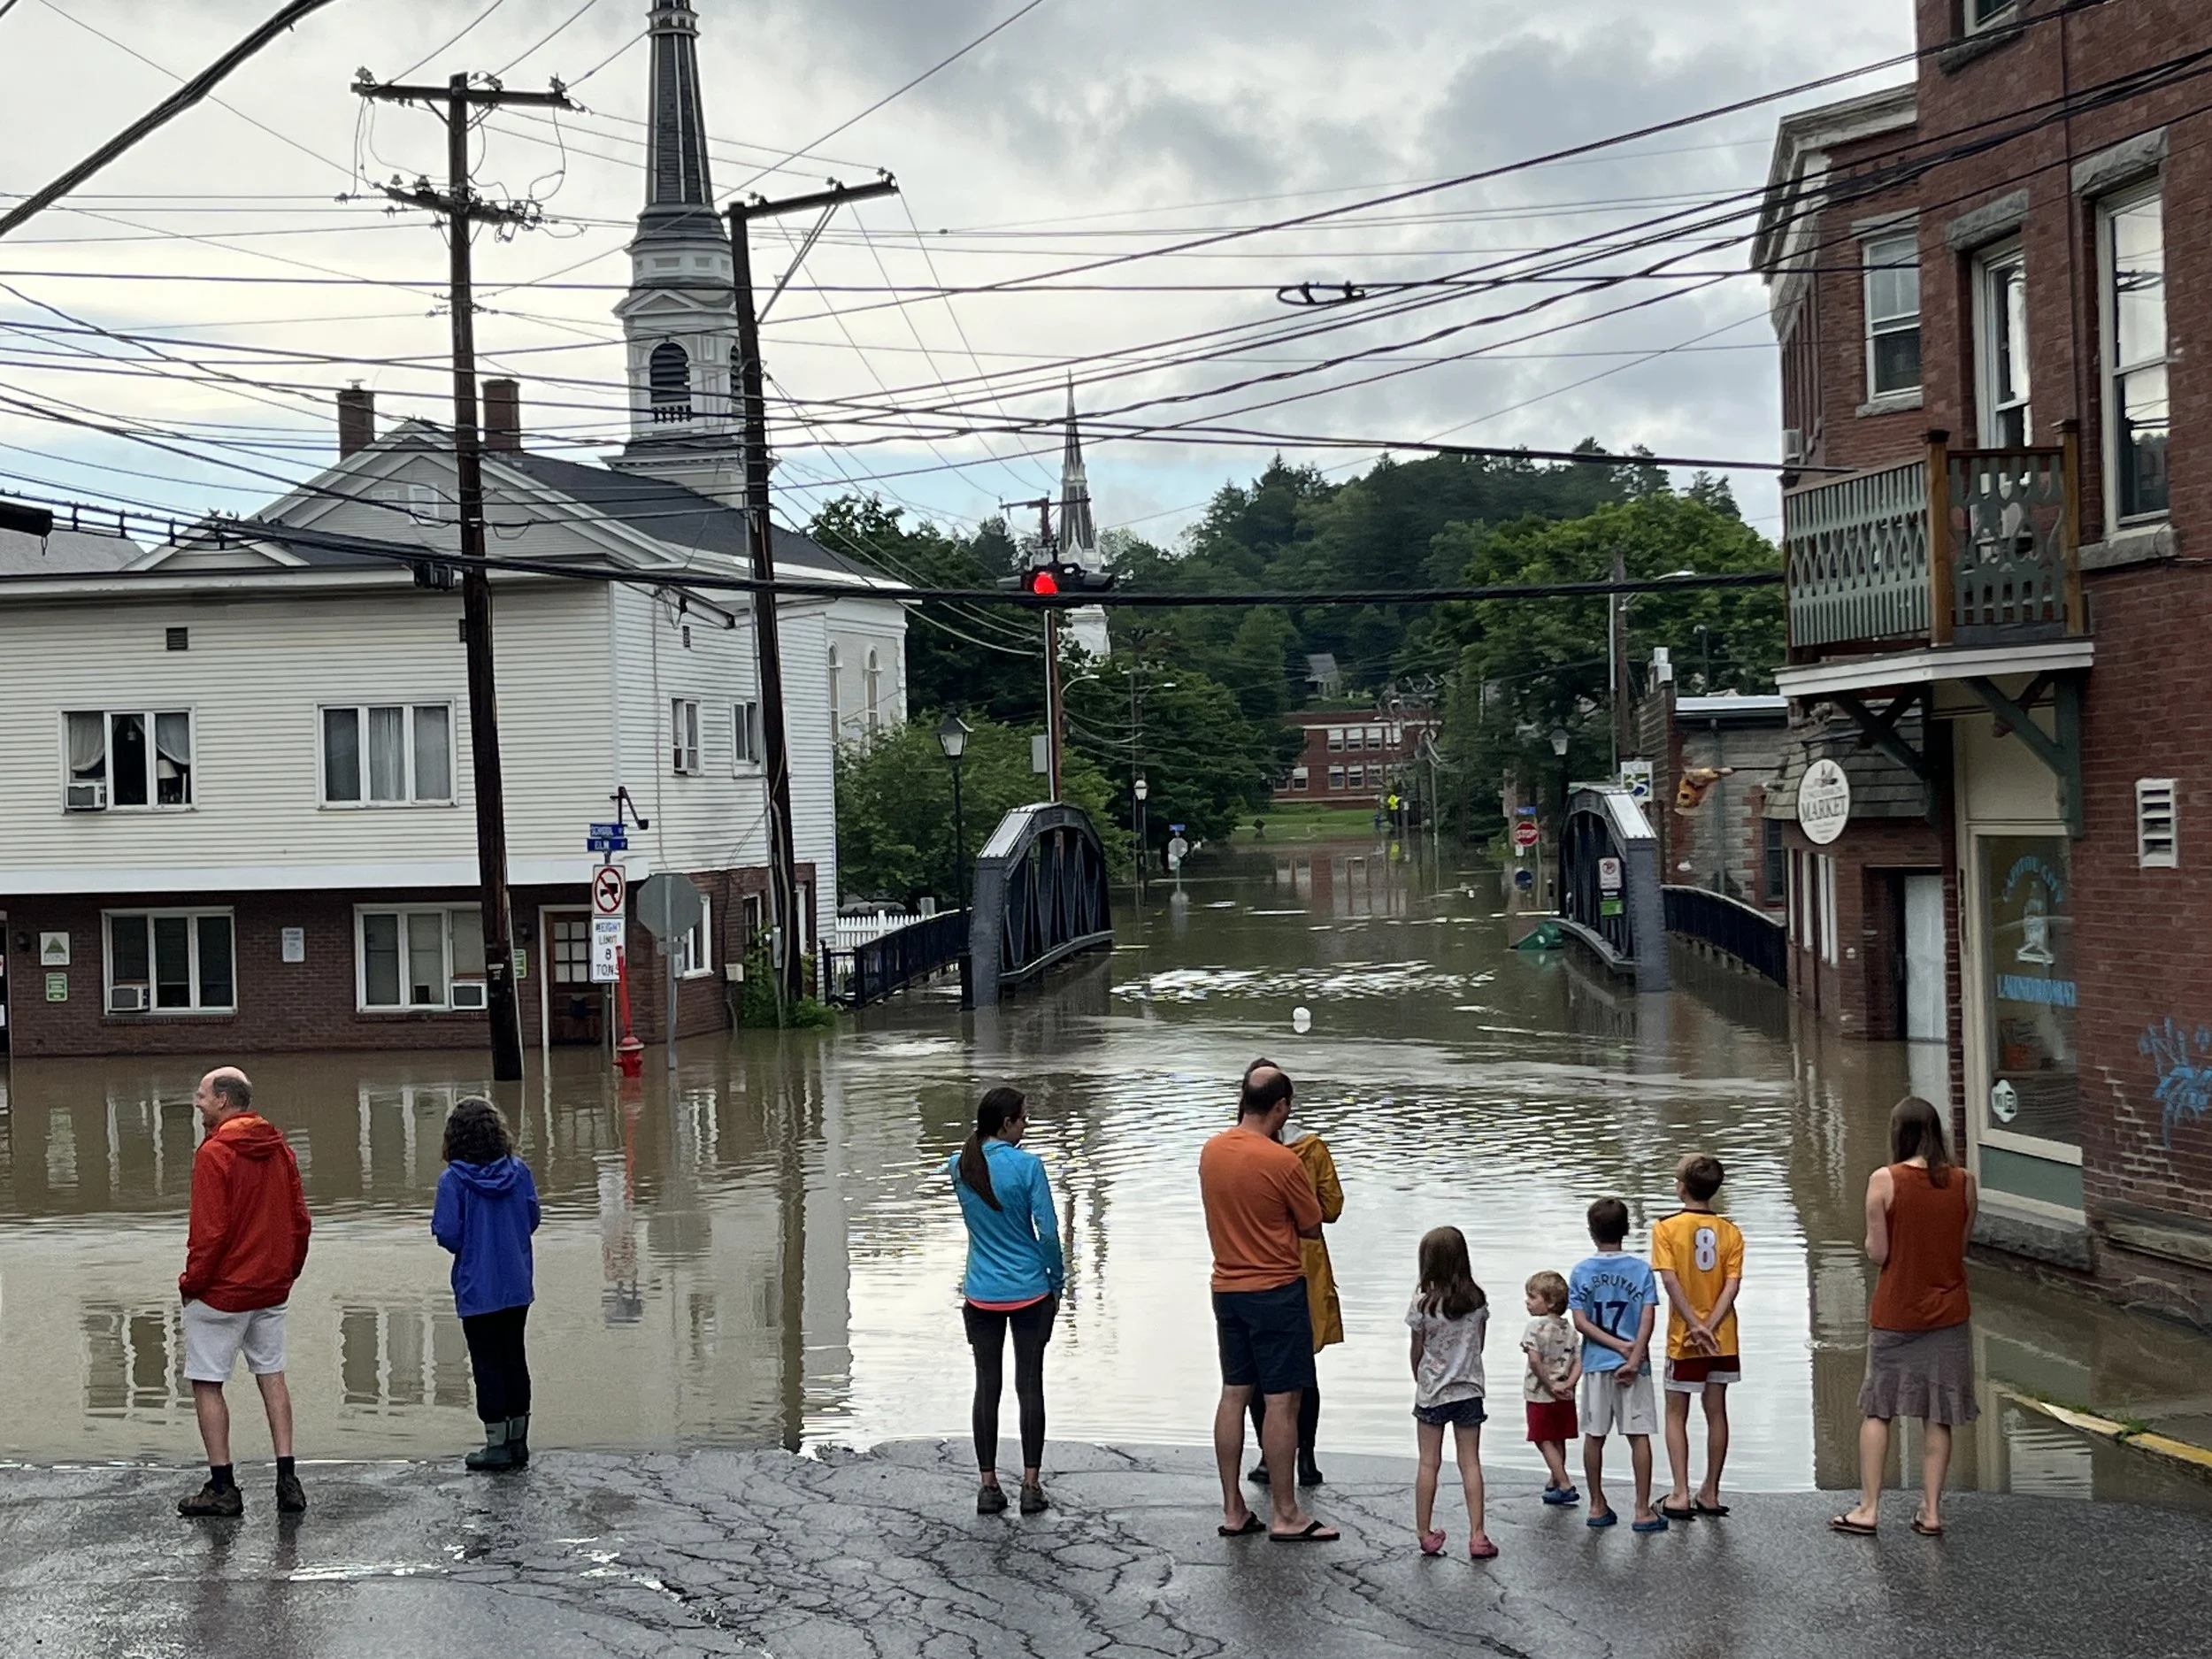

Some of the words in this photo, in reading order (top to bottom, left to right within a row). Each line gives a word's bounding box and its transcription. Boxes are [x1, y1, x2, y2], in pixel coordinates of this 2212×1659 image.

[1801, 795, 1847, 822] MARKET
[591, 826, 613, 836] SCHOOL
[1516, 828, 1538, 840] STOP
[595, 840, 610, 850] ELM
[595, 922, 622, 933] WEIGHT
[598, 935, 618, 946] LIMIT
[605, 948, 612, 961] 8
[1997, 974, 2076, 1007] LAUNDROMAT
[1694, 1226, 1717, 1272] 8
[1578, 1284, 1593, 1302] DE
[1592, 1273, 1644, 1302] BRUYNE
[1594, 1301, 1629, 1335] 17
